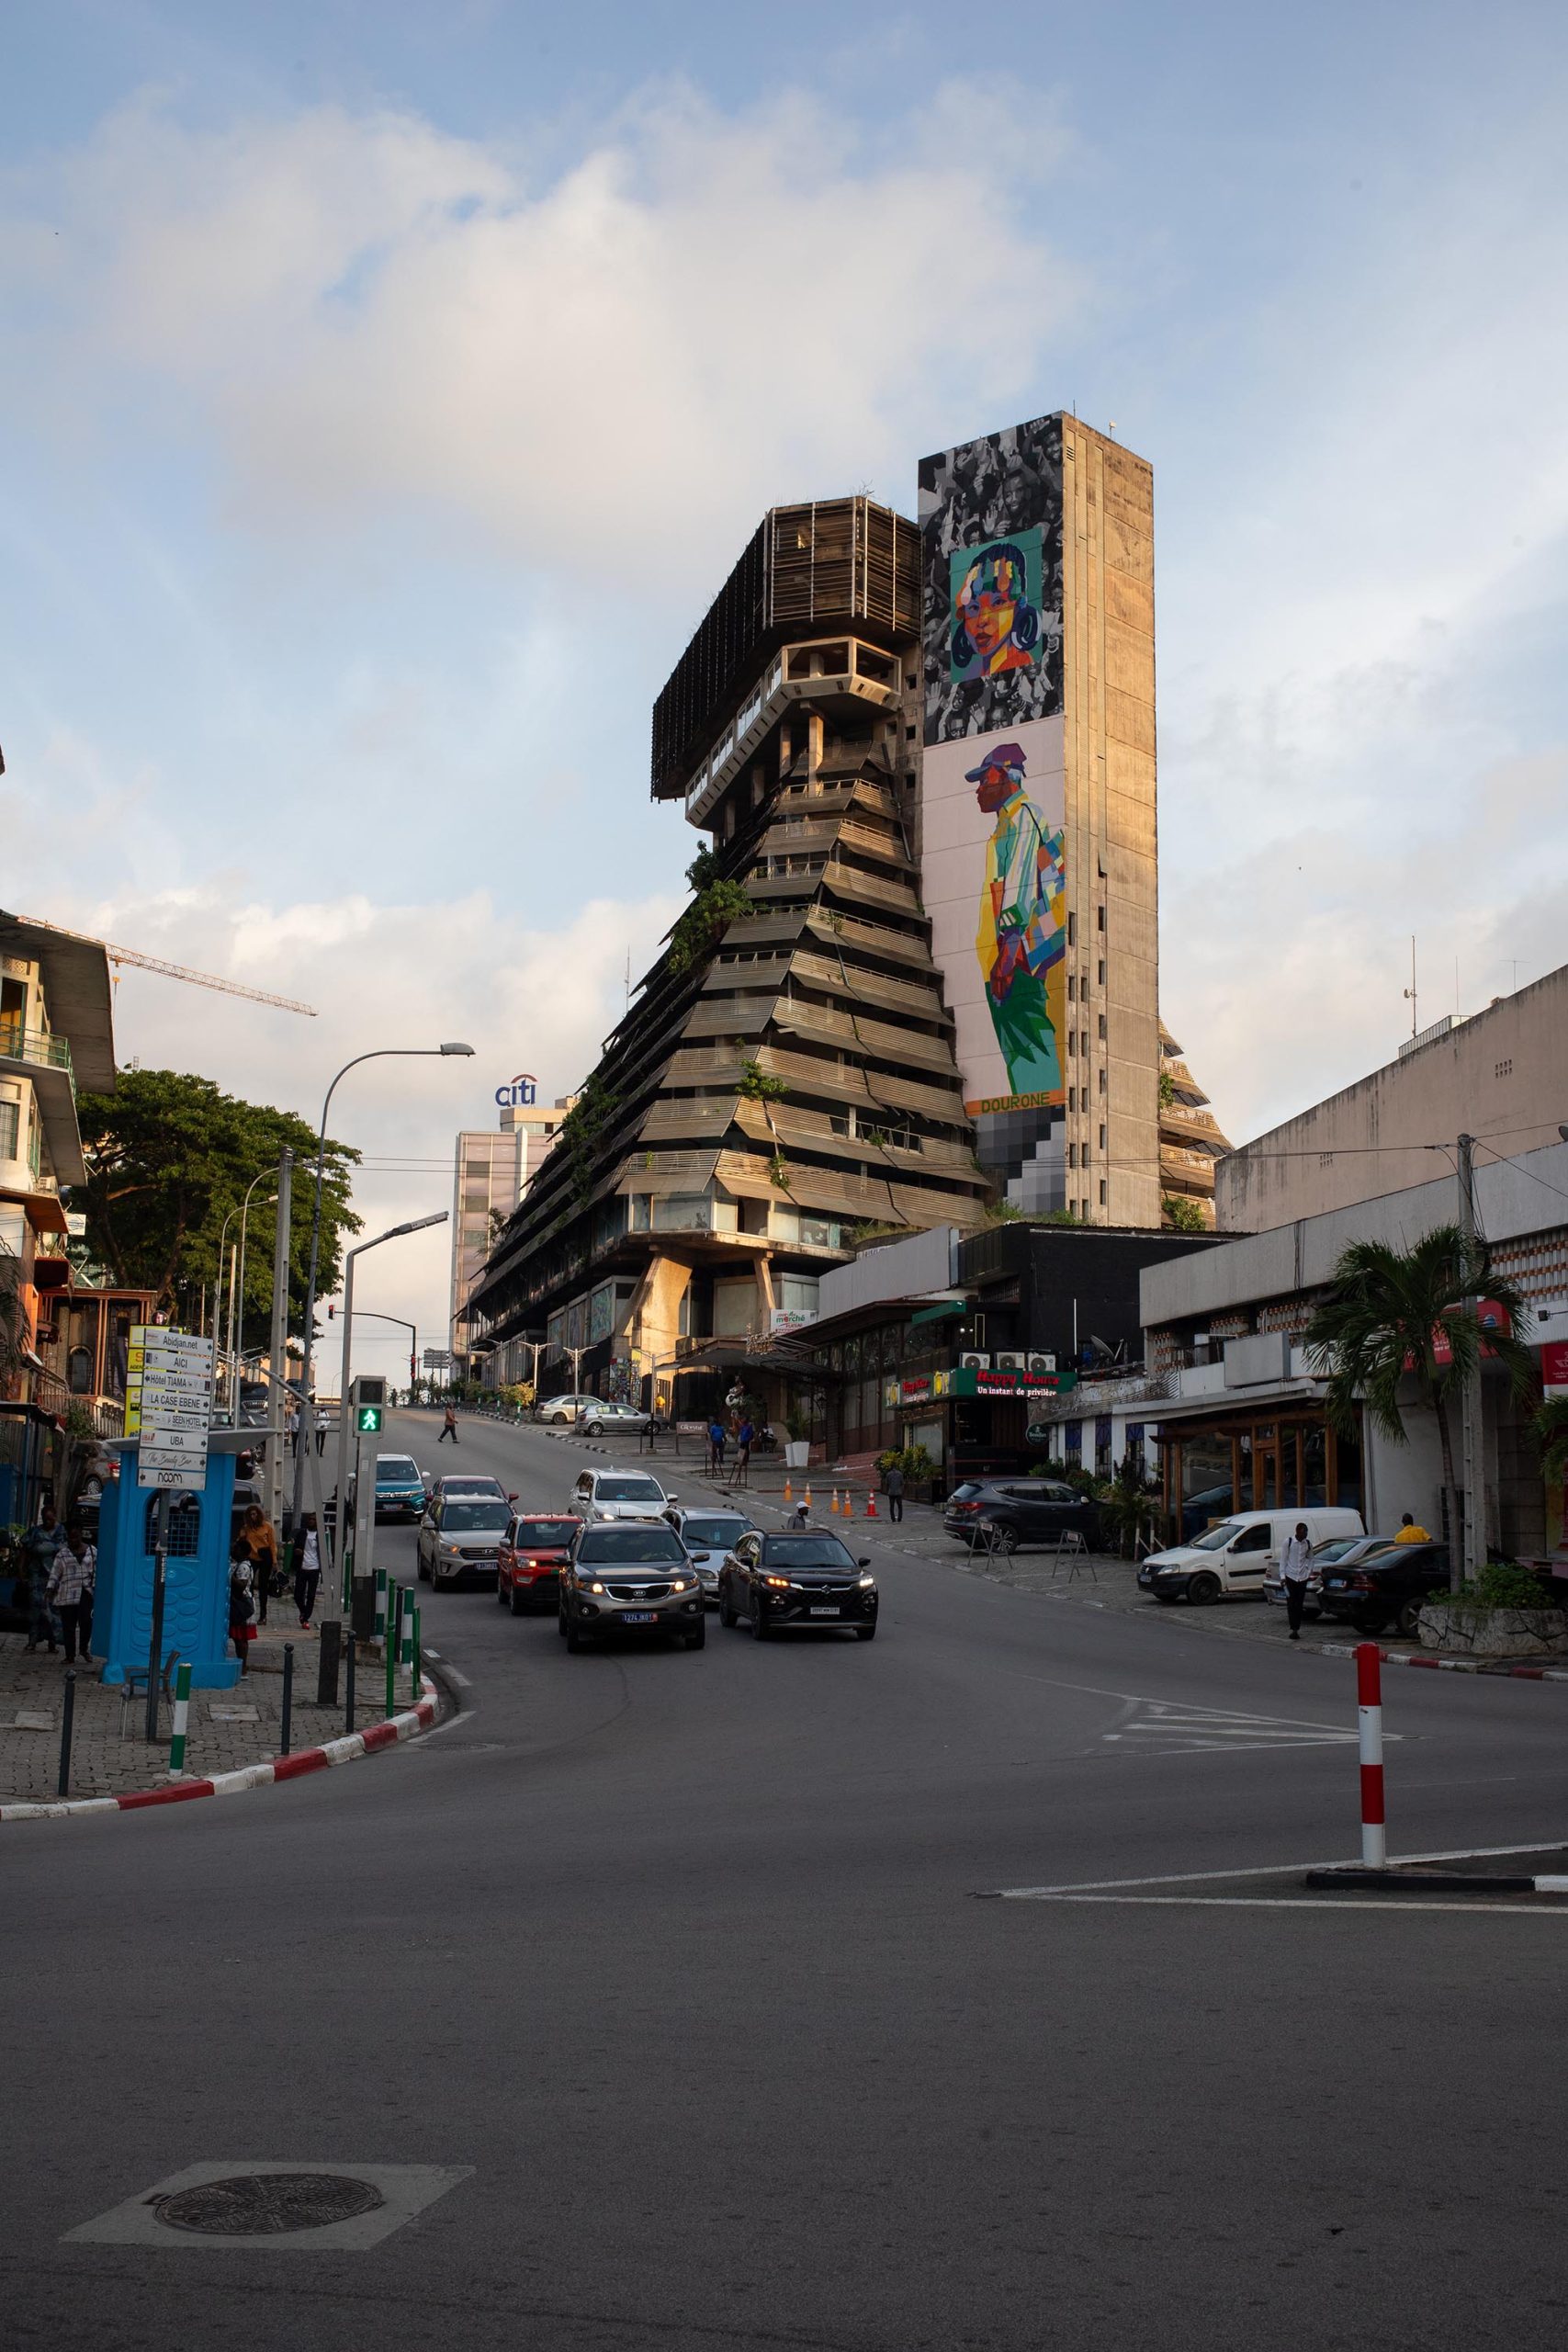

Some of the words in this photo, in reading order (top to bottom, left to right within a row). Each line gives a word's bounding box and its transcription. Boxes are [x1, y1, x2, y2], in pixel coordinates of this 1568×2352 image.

[494, 1078, 536, 1106] citi
[981, 1091, 1051, 1114] DOURONE
[163, 1335, 197, 1350] Abidjan.net
[174, 1357, 187, 1369] AICI
[151, 1374, 166, 1385] Hôtel
[167, 1376, 186, 1387] TIAMA
[976, 1369, 1017, 1385] Happy
[977, 1385, 987, 1395] Un
[988, 1385, 1014, 1395] instant
[1016, 1386, 1024, 1396] de
[1027, 1387, 1057, 1396] privilège
[151, 1394, 159, 1404] LA
[160, 1395, 178, 1406] CASE
[179, 1397, 200, 1408] EBENE
[172, 1416, 185, 1424] SEEN
[186, 1417, 201, 1426] HOTEL
[170, 1436, 184, 1446] UBA
[158, 1472, 183, 1484] noom
